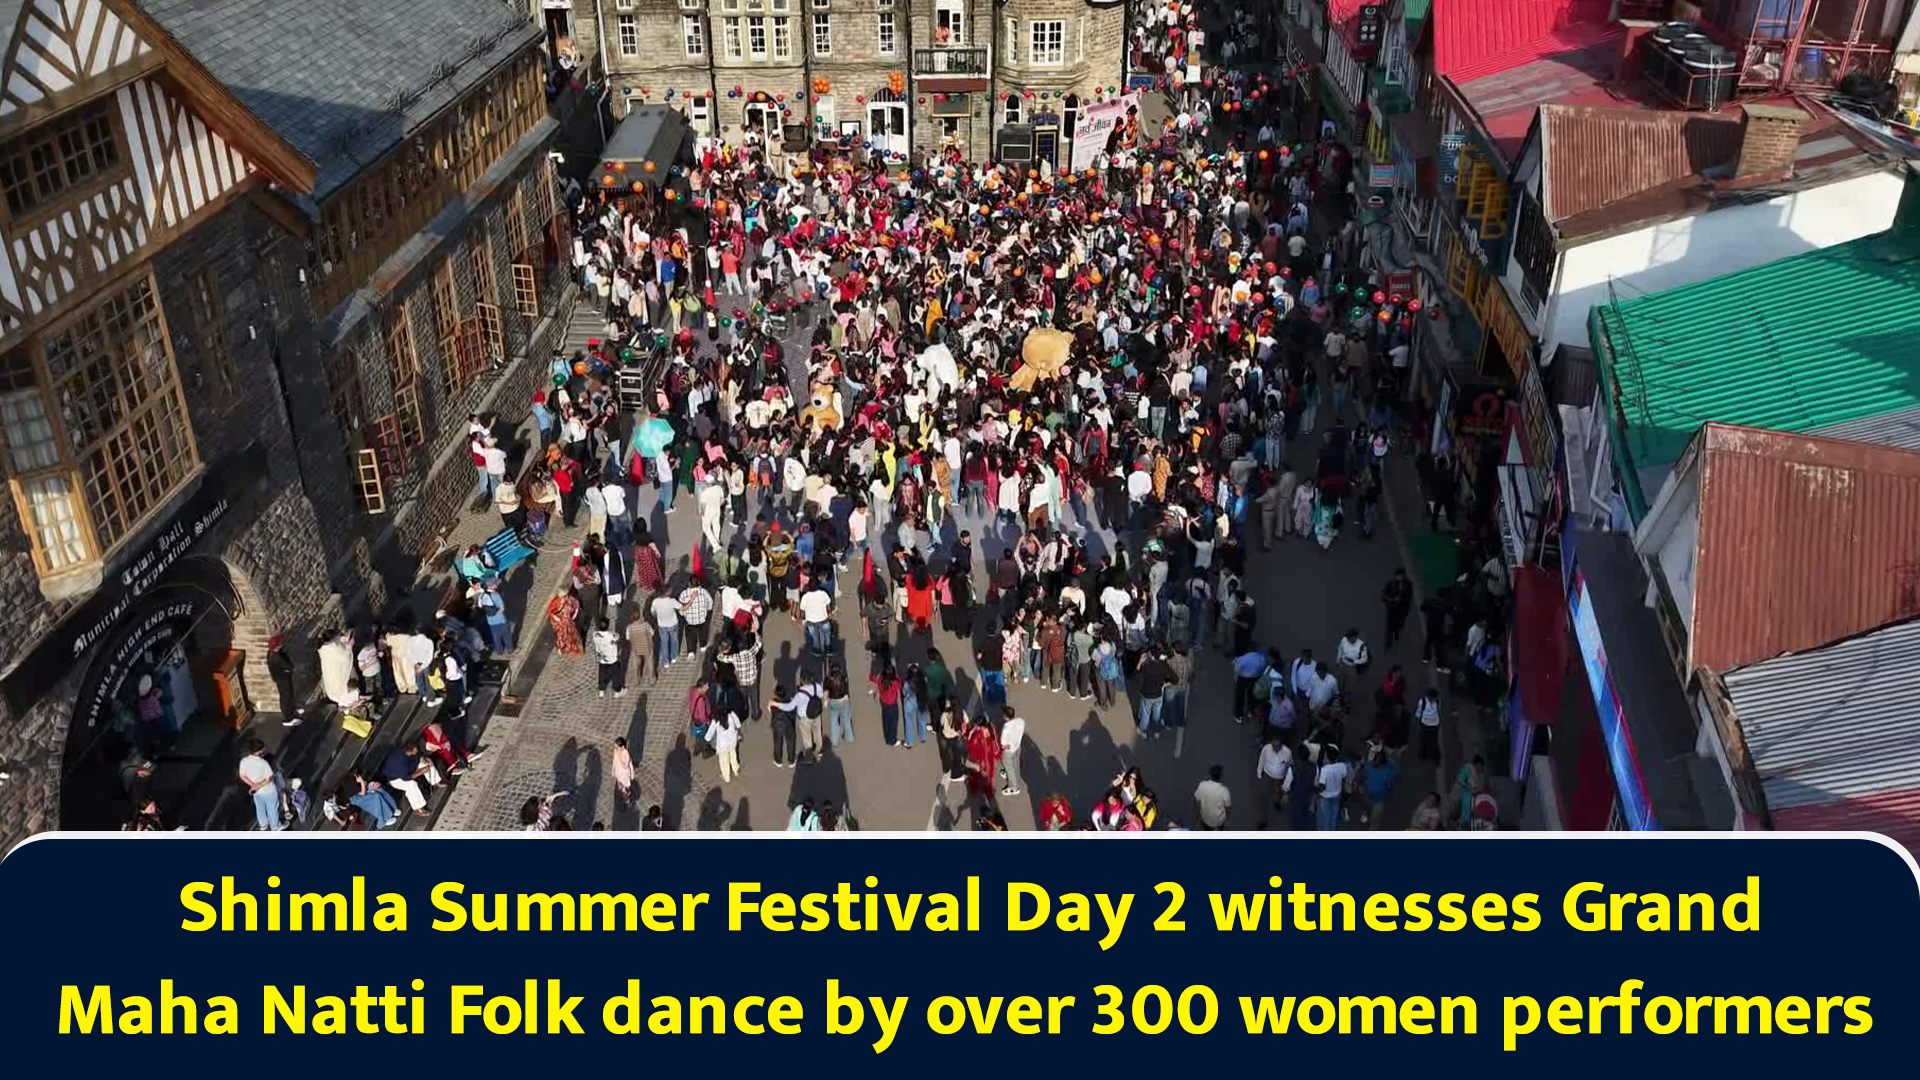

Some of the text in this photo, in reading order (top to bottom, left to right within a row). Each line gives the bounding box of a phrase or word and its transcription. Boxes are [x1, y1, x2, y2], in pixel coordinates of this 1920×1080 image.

[73, 499, 228, 658] Municipal Corporation Shimla
[121, 521, 184, 585] Town Hall
[88, 601, 193, 727] SHIMLA HIGH END CAFÉ
